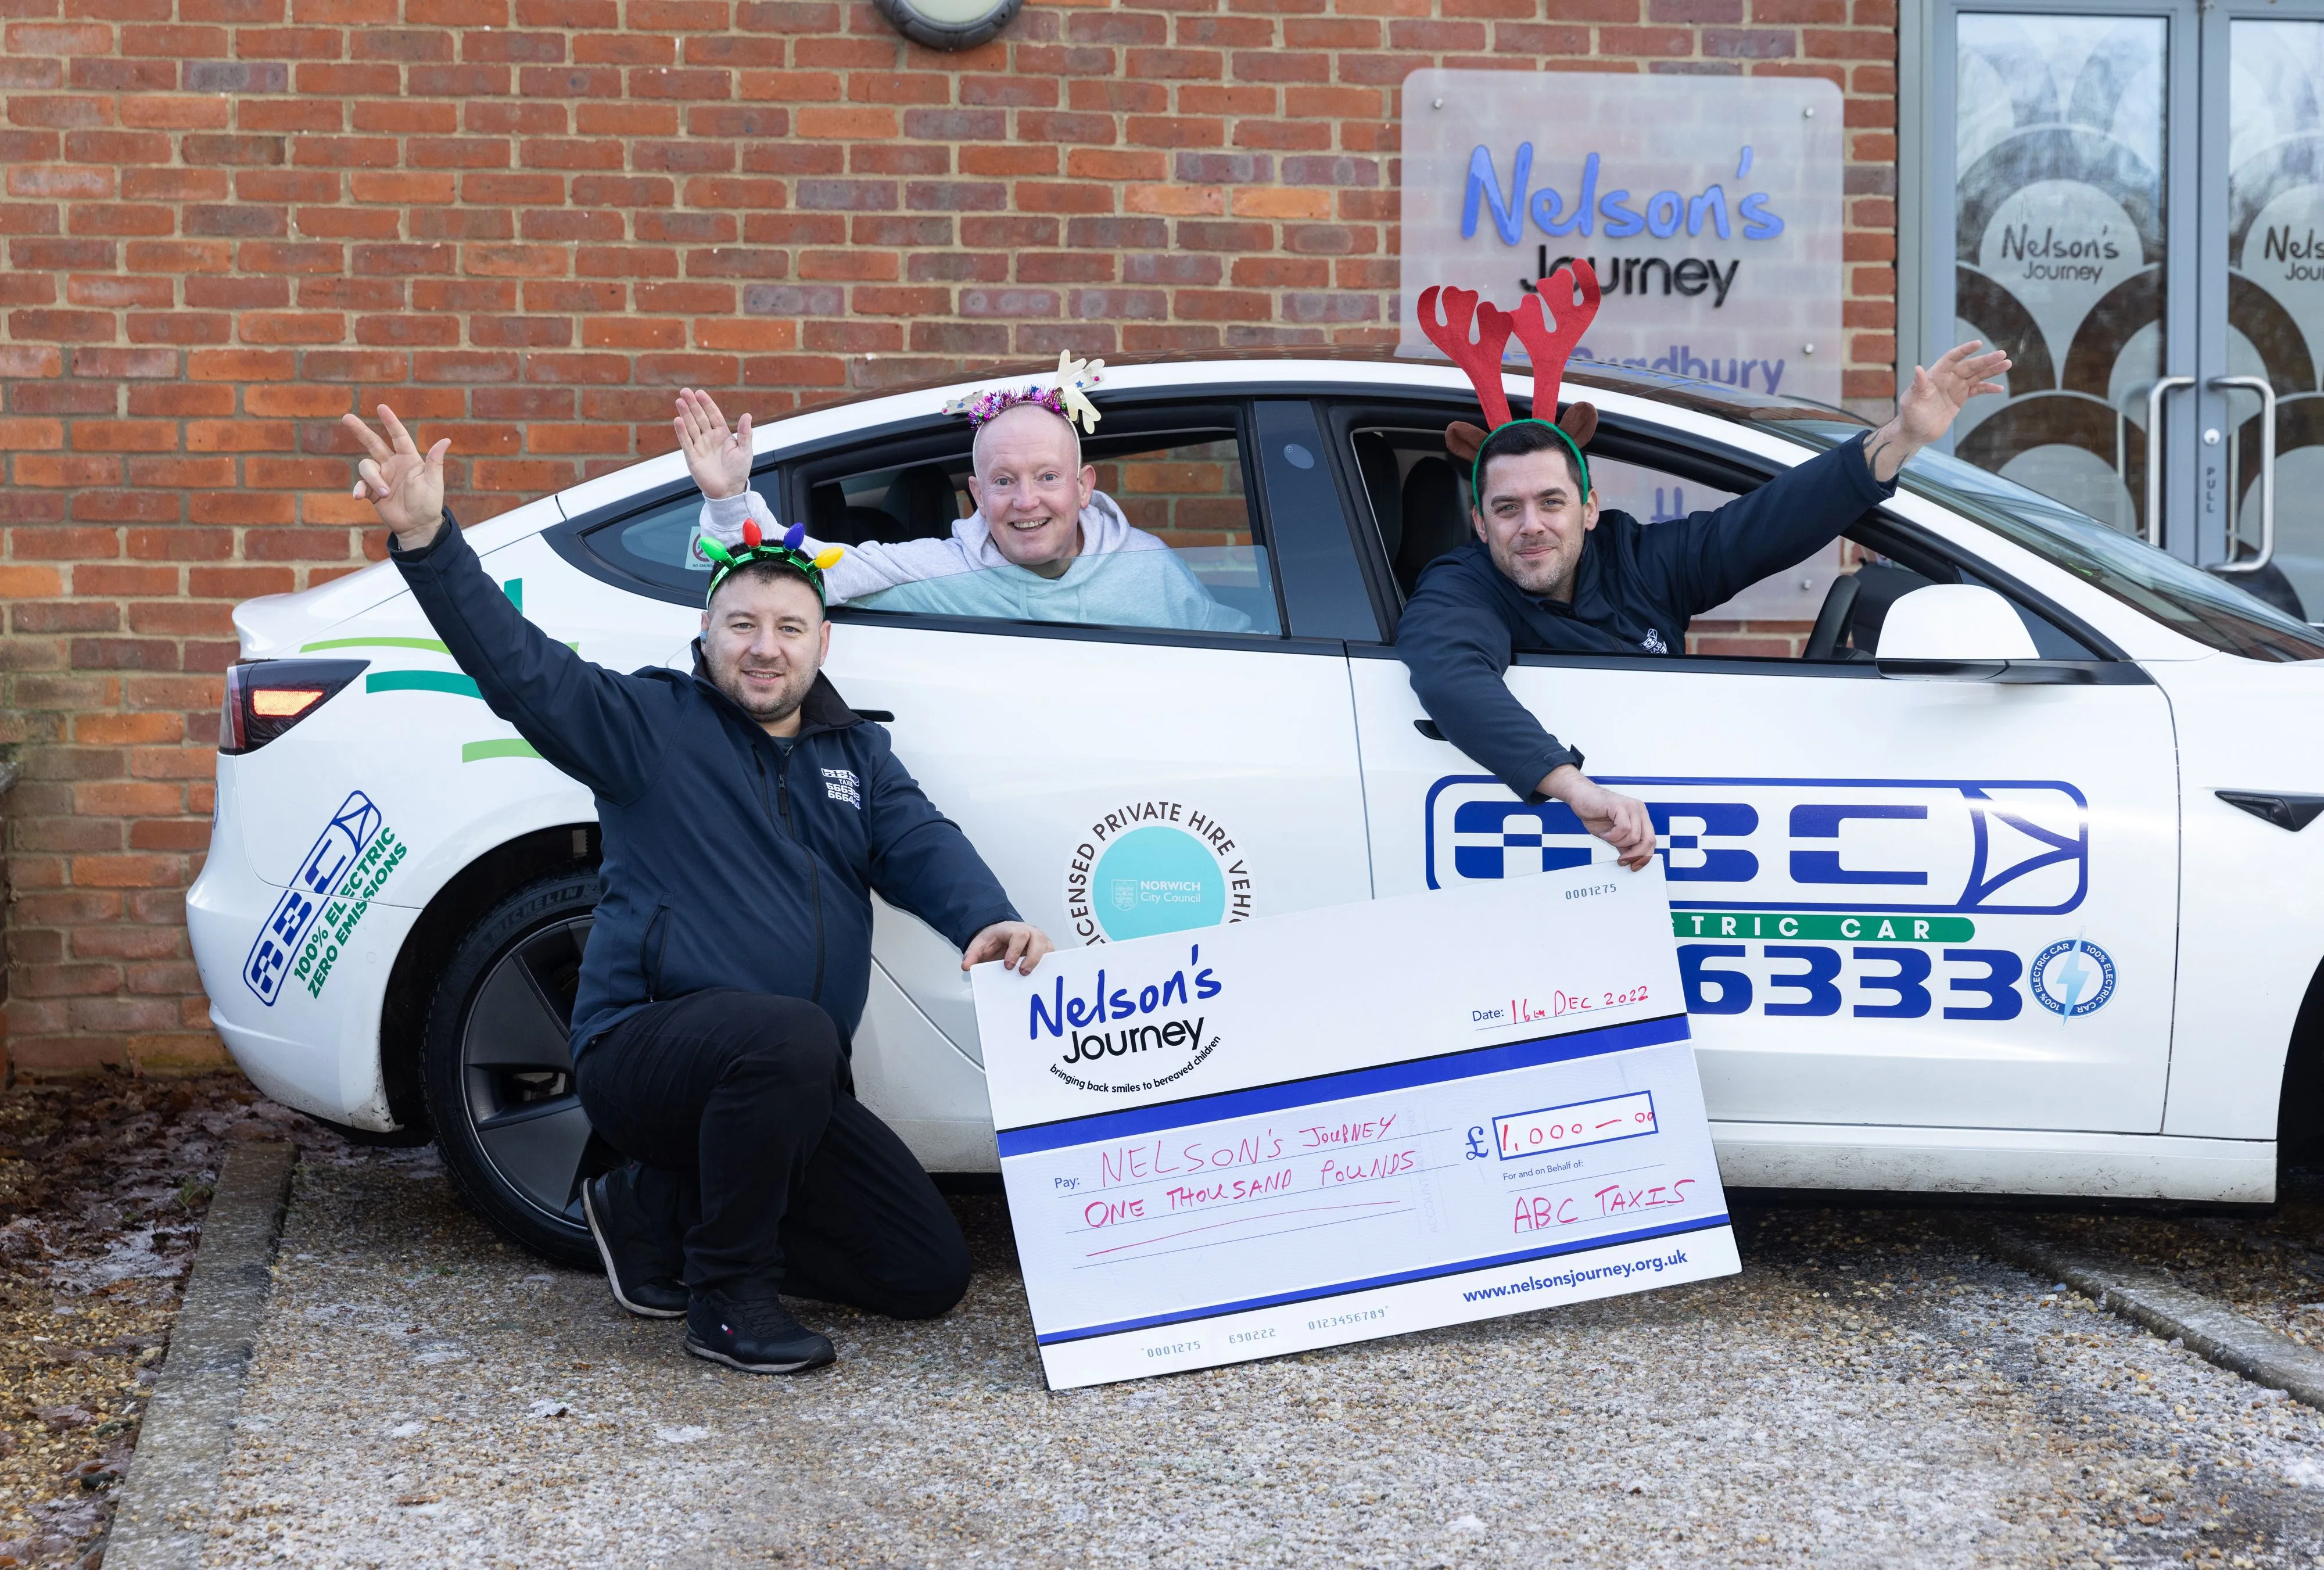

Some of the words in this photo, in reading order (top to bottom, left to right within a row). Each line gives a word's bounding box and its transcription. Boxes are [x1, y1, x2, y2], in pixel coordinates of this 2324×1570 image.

[1461, 141, 1785, 246] Nelson's
[2001, 224, 2120, 261] Nelson's
[2022, 261, 2103, 284] Journey
[2284, 261, 2324, 281] Jou
[2206, 467, 2216, 514] PULL
[838, 779, 853, 787] TAXIS
[1068, 843, 1106, 946] ICENSED
[1093, 801, 1182, 841] PRIVATE
[1188, 811, 1236, 856] HIRE
[1228, 859, 1251, 923] VEHI
[1141, 880, 1200, 891] NORWICH
[1565, 883, 1617, 900] 0001275
[294, 925, 329, 983] 100%
[325, 827, 395, 928] ELECTRIC
[490, 886, 580, 940] MICHELIN
[1141, 892, 1161, 904] City
[1164, 892, 1200, 902] Council
[307, 945, 338, 999] ZERO
[335, 842, 407, 947] EMISSIONS
[1841, 918, 1930, 939] CAR
[2050, 943, 2070, 954] CAR
[2086, 945, 2107, 963] 100%
[2033, 953, 2050, 993] ELECTRIC
[2096, 963, 2114, 1003] ELECTRIC
[1030, 944, 1222, 1040] Nelson's
[1472, 1007, 1505, 1021] Date:
[1554, 990, 1591, 1017] DEC
[1604, 985, 1649, 1005] 2022
[2039, 994, 2060, 1010] 100%
[2076, 1002, 2096, 1013] CAR
[1063, 1017, 1204, 1064] Journey
[1050, 1063, 1085, 1089] bringing
[1087, 1080, 1109, 1092] back
[1111, 1082, 1141, 1093] smiles
[1142, 1081, 1153, 1089] to
[1154, 1062, 1194, 1087] bereaved
[1194, 1036, 1221, 1066] children
[1465, 1126, 1489, 1160] £
[1054, 1175, 1081, 1190] Pay:
[1503, 1172, 1516, 1181] For
[1519, 1167, 1534, 1178] and
[1547, 1162, 1572, 1173] Behalf
[1573, 1160, 1584, 1168] of:
[1085, 1198, 1145, 1228] ONE
[1514, 1196, 1579, 1234] ABC
[1595, 1180, 1695, 1216] TAXIS
[1463, 1249, 1688, 1303] www.nelsonsjourney.org.uk
[1229, 1328, 1276, 1344] 690222
[1308, 1307, 1386, 1331] 0123456789
